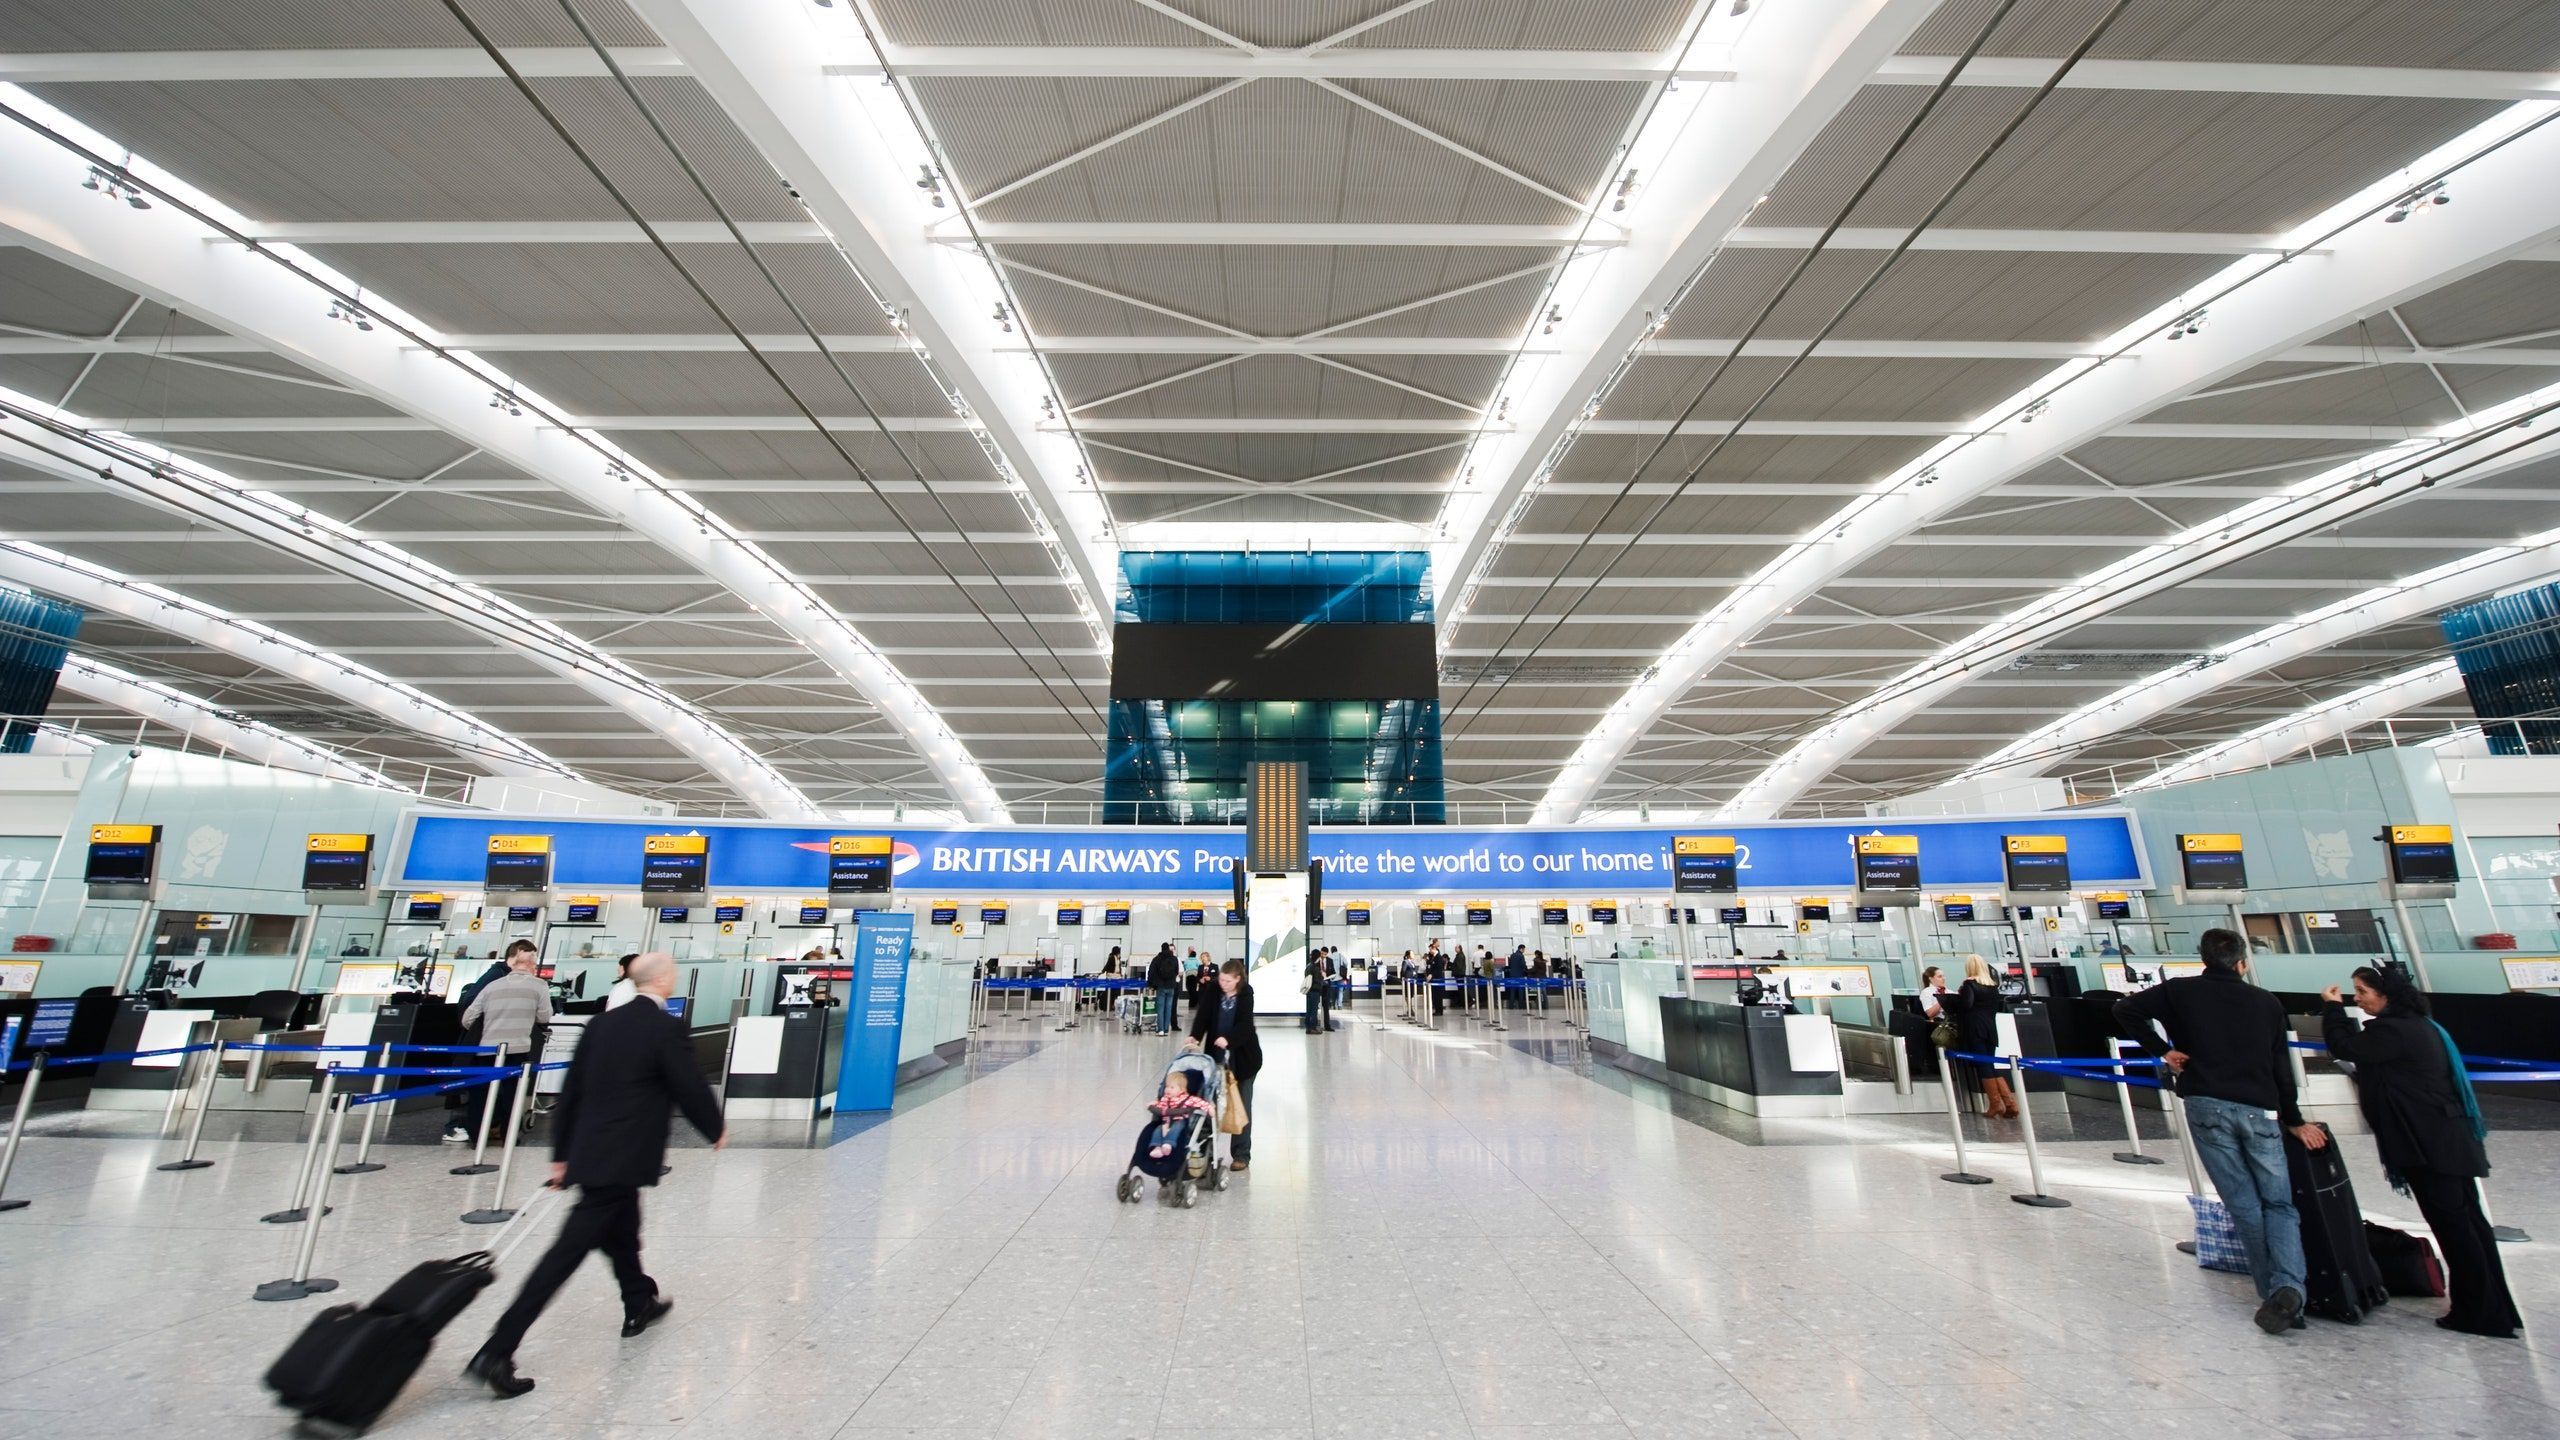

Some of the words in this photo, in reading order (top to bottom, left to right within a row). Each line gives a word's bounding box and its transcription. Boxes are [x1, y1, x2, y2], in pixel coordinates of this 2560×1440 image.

[104, 830, 122, 838] D12
[2406, 830, 2416, 839] F5
[320, 839, 337, 847] D13
[2197, 839, 2207, 847] F4
[932, 847, 1051, 873] BRITISH
[1056, 848, 1181, 873] AIRWAYS
[1376, 849, 1415, 873] the
[1422, 848, 1490, 873] world
[1498, 852, 1524, 873] to
[1532, 854, 1575, 872] our
[1581, 847, 1653, 872] home
[647, 871, 682, 879] Assistance
[832, 872, 868, 880] Assistance
[876, 935, 905, 946] Ready
[874, 946, 885, 955] to
[886, 946, 901, 957] Fly
